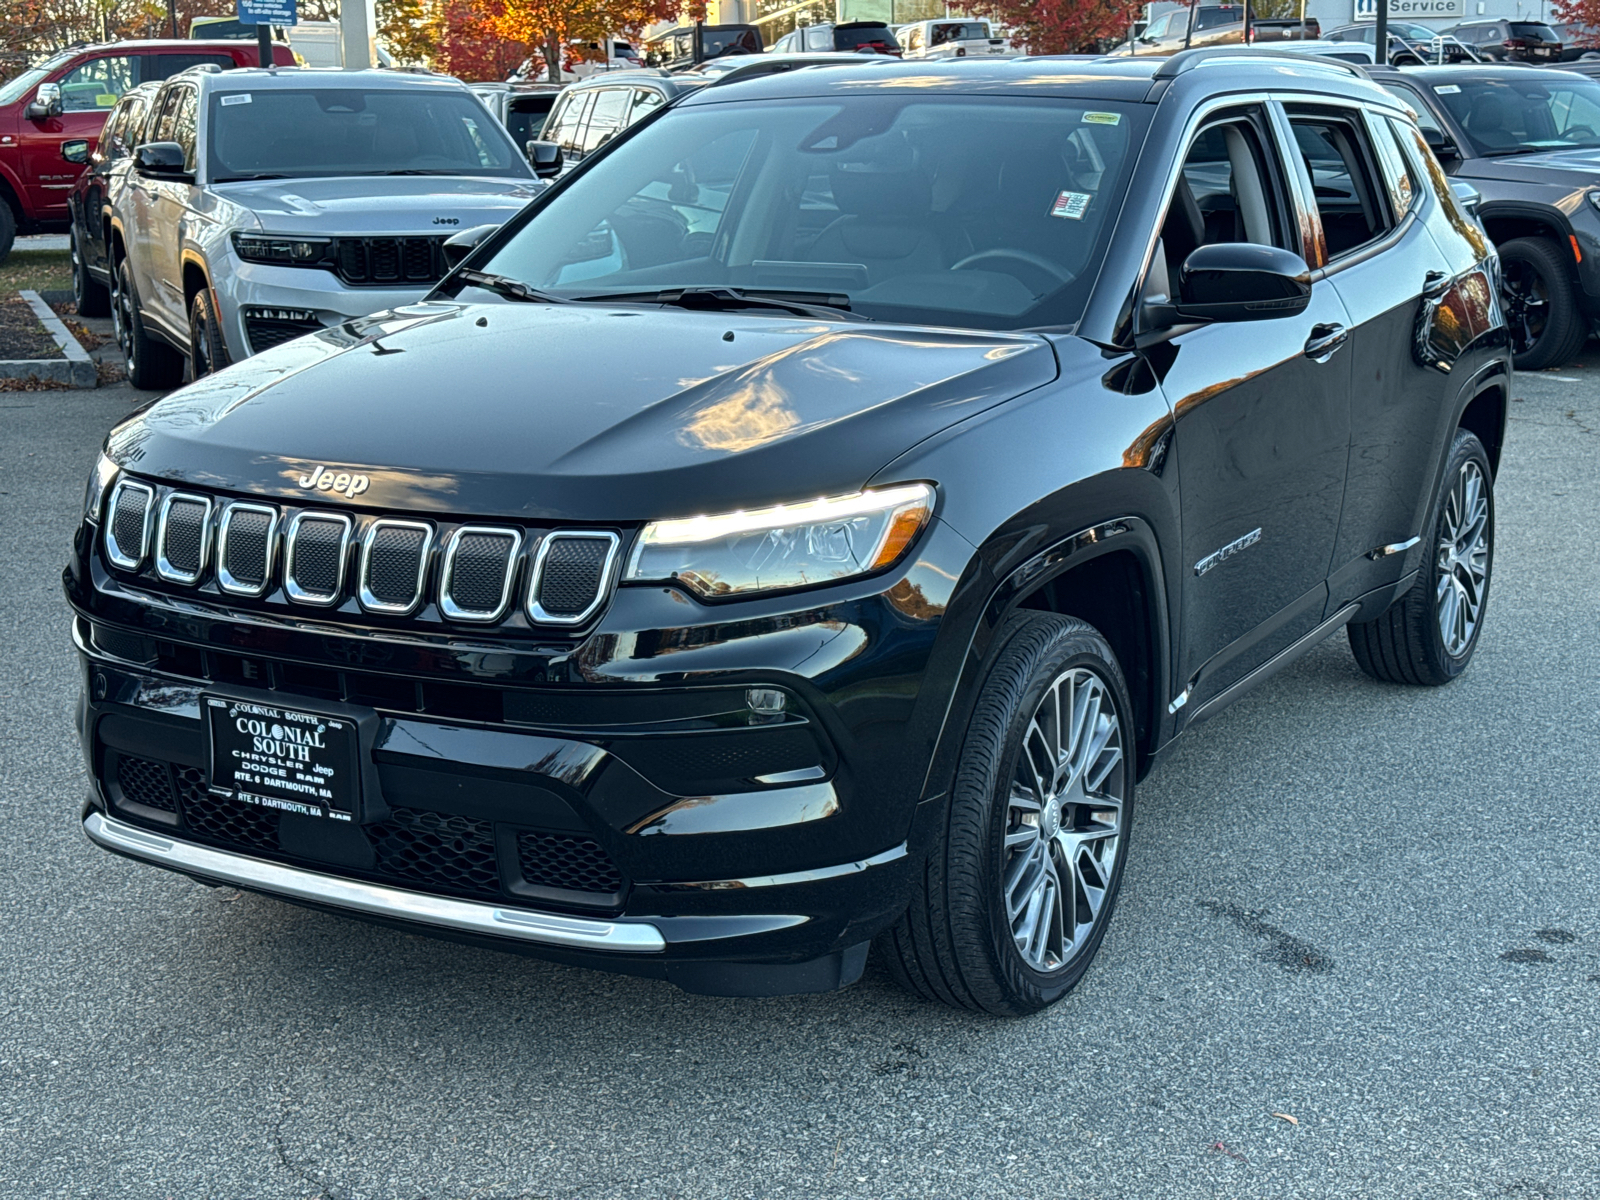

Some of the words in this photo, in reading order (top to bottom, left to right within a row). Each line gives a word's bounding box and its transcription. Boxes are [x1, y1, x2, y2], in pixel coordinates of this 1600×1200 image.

[1389, 0, 1456, 11] Service
[432, 217, 460, 226] Jeep
[299, 465, 369, 499] Jeep
[234, 703, 280, 718] COLONIAL
[284, 712, 319, 726] SOUTH
[236, 717, 325, 749] COLONIAL
[328, 720, 343, 730] Jeep
[253, 736, 310, 763] SOUTH
[232, 750, 304, 770] CHRYSLER
[241, 761, 288, 777] DODGE
[296, 772, 325, 784] RAM
[312, 763, 335, 777] Jeep
[234, 771, 252, 783] RTE.
[254, 776, 261, 784] 6
[264, 777, 318, 796] DARTMOUTH,
[319, 788, 333, 799] MA
[238, 792, 254, 804] RTE.
[254, 797, 260, 805] 6
[262, 798, 309, 816] DARTMOUTH,
[309, 807, 322, 817] MA
[329, 812, 352, 822] RAM
